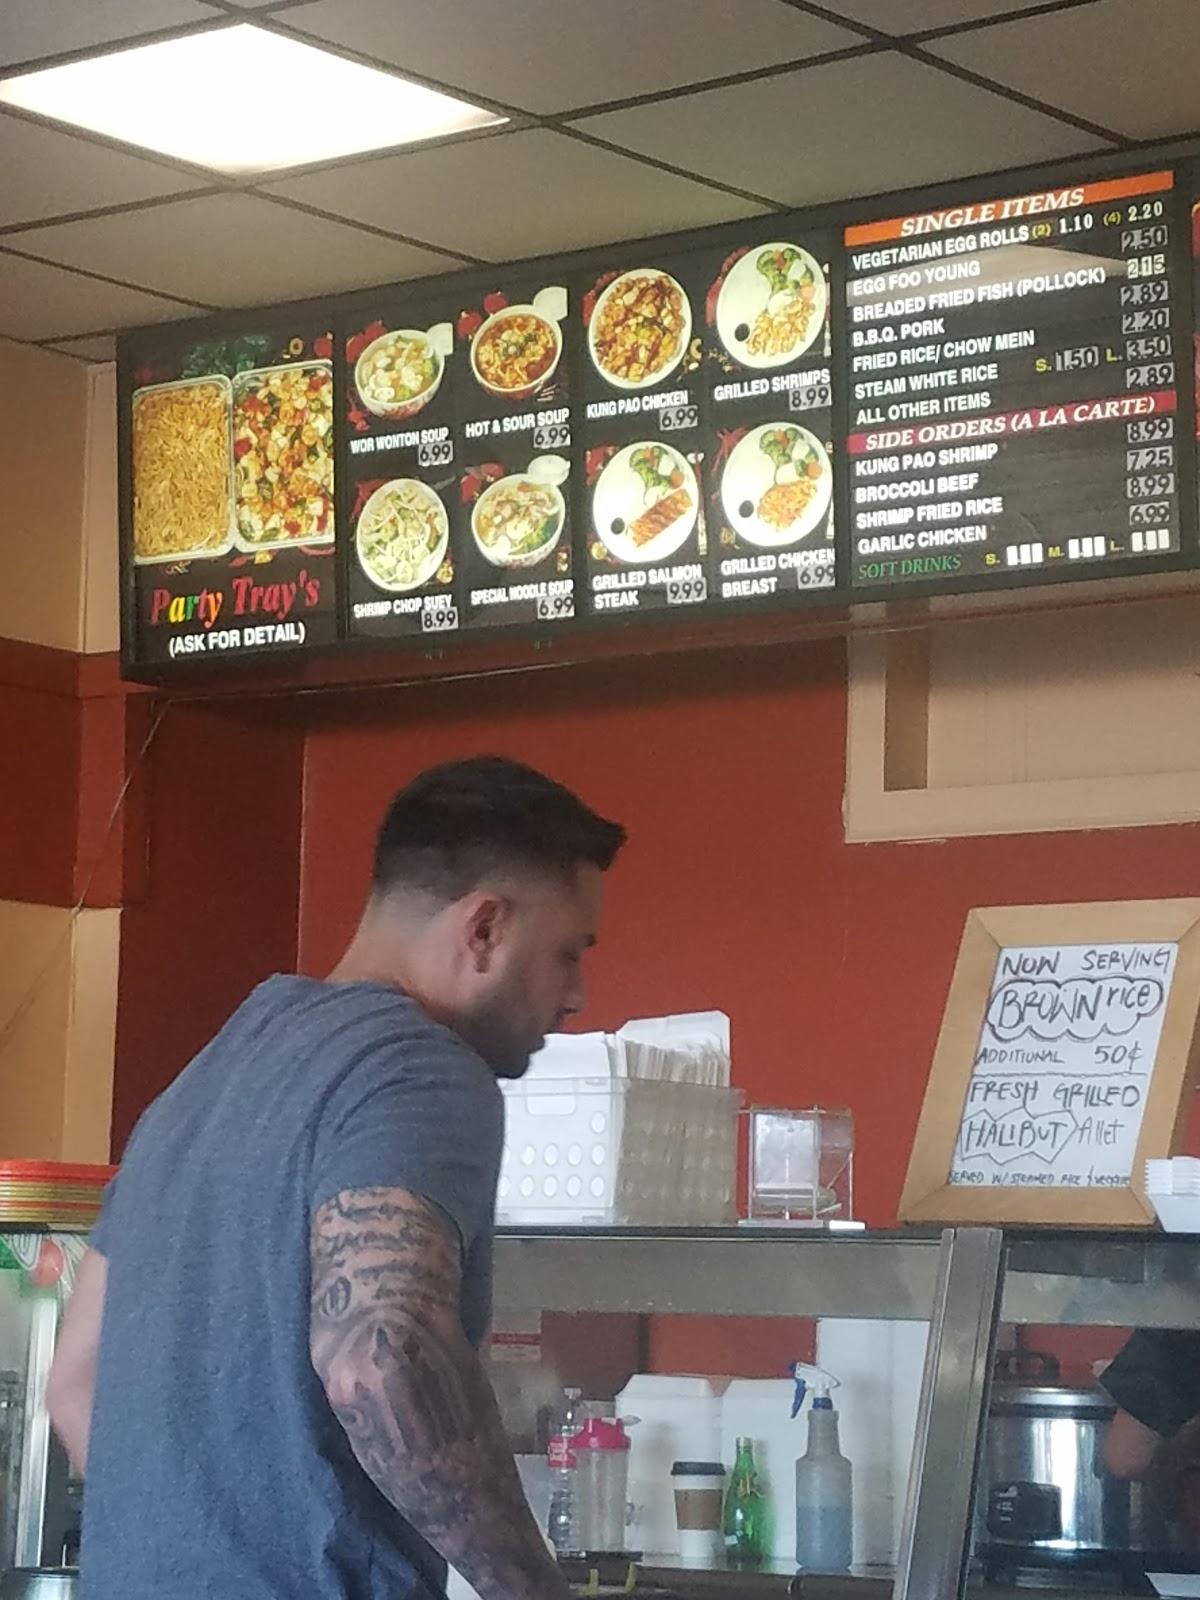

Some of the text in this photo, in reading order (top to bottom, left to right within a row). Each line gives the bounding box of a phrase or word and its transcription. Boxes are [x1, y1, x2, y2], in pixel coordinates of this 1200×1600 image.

[900, 187, 1085, 237] SINGLE ITEMS
[852, 240, 942, 271] VEGETARIAN
[945, 234, 977, 255] EGG
[980, 225, 1029, 249] ROLLS
[1032, 224, 1051, 239] (2)
[1059, 213, 1093, 234] 1.10
[1128, 201, 1163, 222] 2.20
[853, 227, 1168, 296] EGG FOO YOUNG 2.50
[852, 255, 1165, 322] BREADED FRIED FISH (POLLOCK) 2.15
[853, 282, 1168, 347] B.B.Q. PORK 2.89
[853, 309, 1169, 372] FRIED RICE/ CHOW MEIN 2.20
[854, 336, 1171, 399] STEAM WHITE RICE S. 1.50 L. 3.50
[714, 368, 831, 401] GRILLED SHRIMPS
[791, 387, 831, 408] 8.99
[857, 363, 1174, 425] ALL OTHER ITEMS 2.89
[586, 390, 689, 418] KUNG PAO CHICKEN
[661, 407, 699, 428] 6.99
[465, 407, 570, 438] HOT & SOUR SOUP
[534, 426, 570, 446] 6.99
[865, 396, 1155, 450] SIDE ORDERS (A LA CARTE)
[350, 427, 449, 454] WOR WONTON SOUP
[419, 443, 451, 463] 6.99
[856, 418, 1173, 476] KUNG PAO SHRIMP 8.99
[855, 447, 1172, 503] BROCCOLI BEEF 7.25
[856, 474, 1174, 529] SHRIMP FRIED RICE 8.99
[857, 502, 1169, 555] GARLIC CHICKEN 6.99
[720, 548, 836, 576] GRILLED CHICKEN
[859, 560, 898, 580] SOFT
[901, 554, 961, 575] DRINKS
[1110, 539, 1125, 551] L.
[592, 563, 702, 591] GRILLED SALMON
[669, 580, 705, 600] 9.99
[722, 577, 778, 598] BREAST
[799, 565, 836, 586] 6.99
[150, 569, 321, 629] Party Tray's
[353, 594, 452, 618] SHRIMP CHOP SUEY
[471, 579, 574, 606] SPECIAL NOODLE SOUP
[538, 597, 574, 618] 6.99
[593, 590, 639, 609] STEAK
[423, 609, 457, 629] 8.99
[169, 622, 306, 658] (ASK FOR DETAIL)
[1002, 947, 1171, 975] NOW SERVING
[998, 985, 1103, 1029] BROWN
[976, 1041, 1144, 1072] ADDITIONAL 50¢
[970, 1080, 1140, 1108] FRESH GRILLED
[965, 1119, 1068, 1153] HALIBUT
